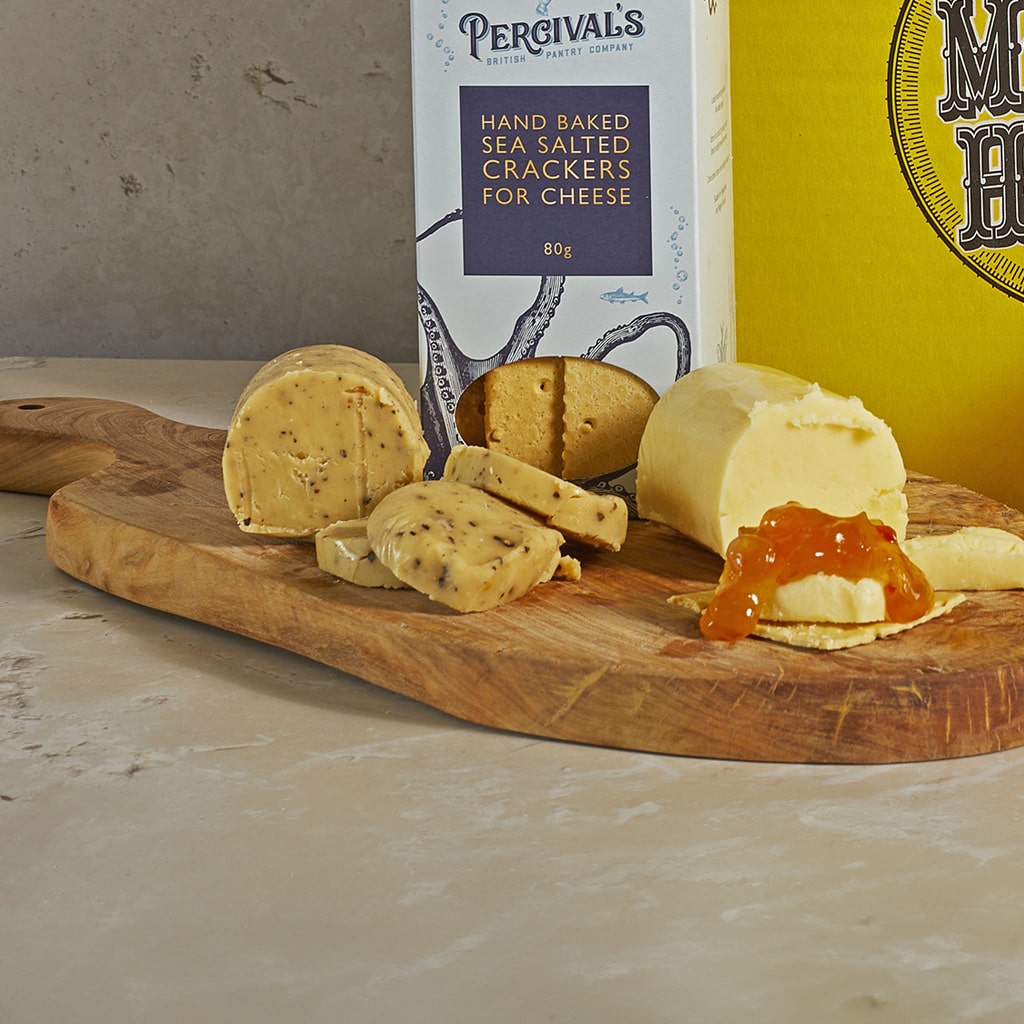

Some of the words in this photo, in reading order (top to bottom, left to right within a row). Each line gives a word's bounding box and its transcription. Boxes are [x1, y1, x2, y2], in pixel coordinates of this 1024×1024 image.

[458, 2, 646, 63] PERCIVAL'S
[486, 55, 526, 66] BRITISH
[546, 47, 582, 59] PANTRY
[589, 42, 634, 54] COMPANY
[480, 113, 547, 130] HAND
[557, 113, 630, 130] BAKED
[481, 136, 526, 154] SEA
[537, 136, 631, 154] SALTED
[482, 159, 631, 180] CRACKERS
[482, 187, 530, 205] FOR
[541, 187, 631, 205] CHEESE
[543, 242, 572, 259] 80g
